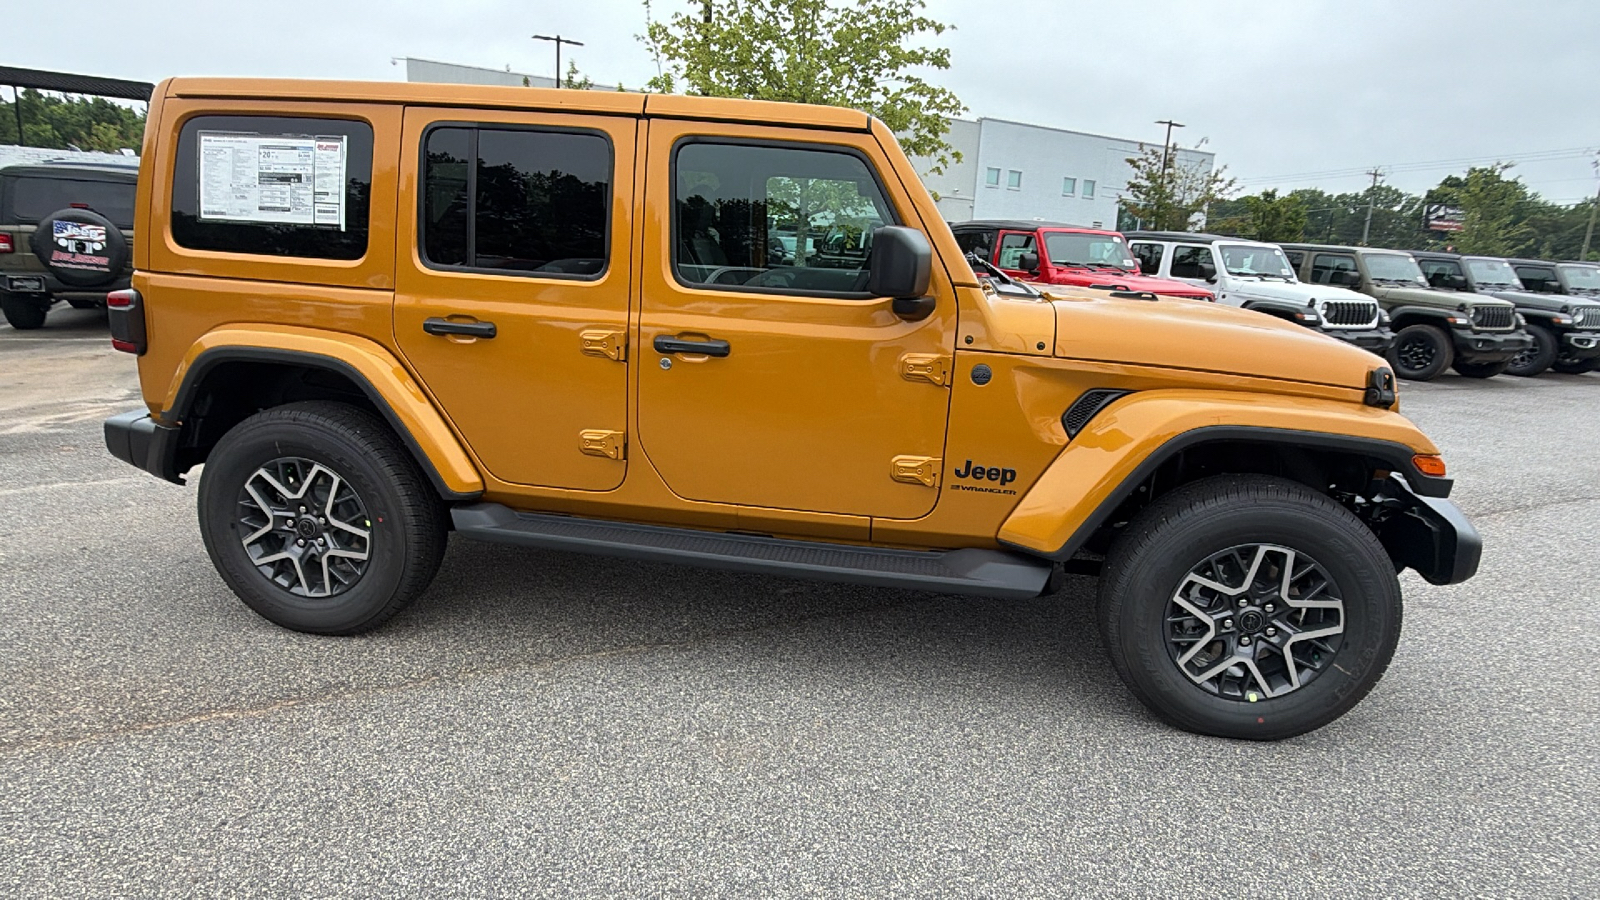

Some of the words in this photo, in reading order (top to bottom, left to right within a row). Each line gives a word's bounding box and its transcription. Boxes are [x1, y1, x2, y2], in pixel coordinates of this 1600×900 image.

[63, 224, 99, 239] Jeep
[954, 459, 1017, 486] Jeep
[960, 485, 1017, 496] WRANGLER
